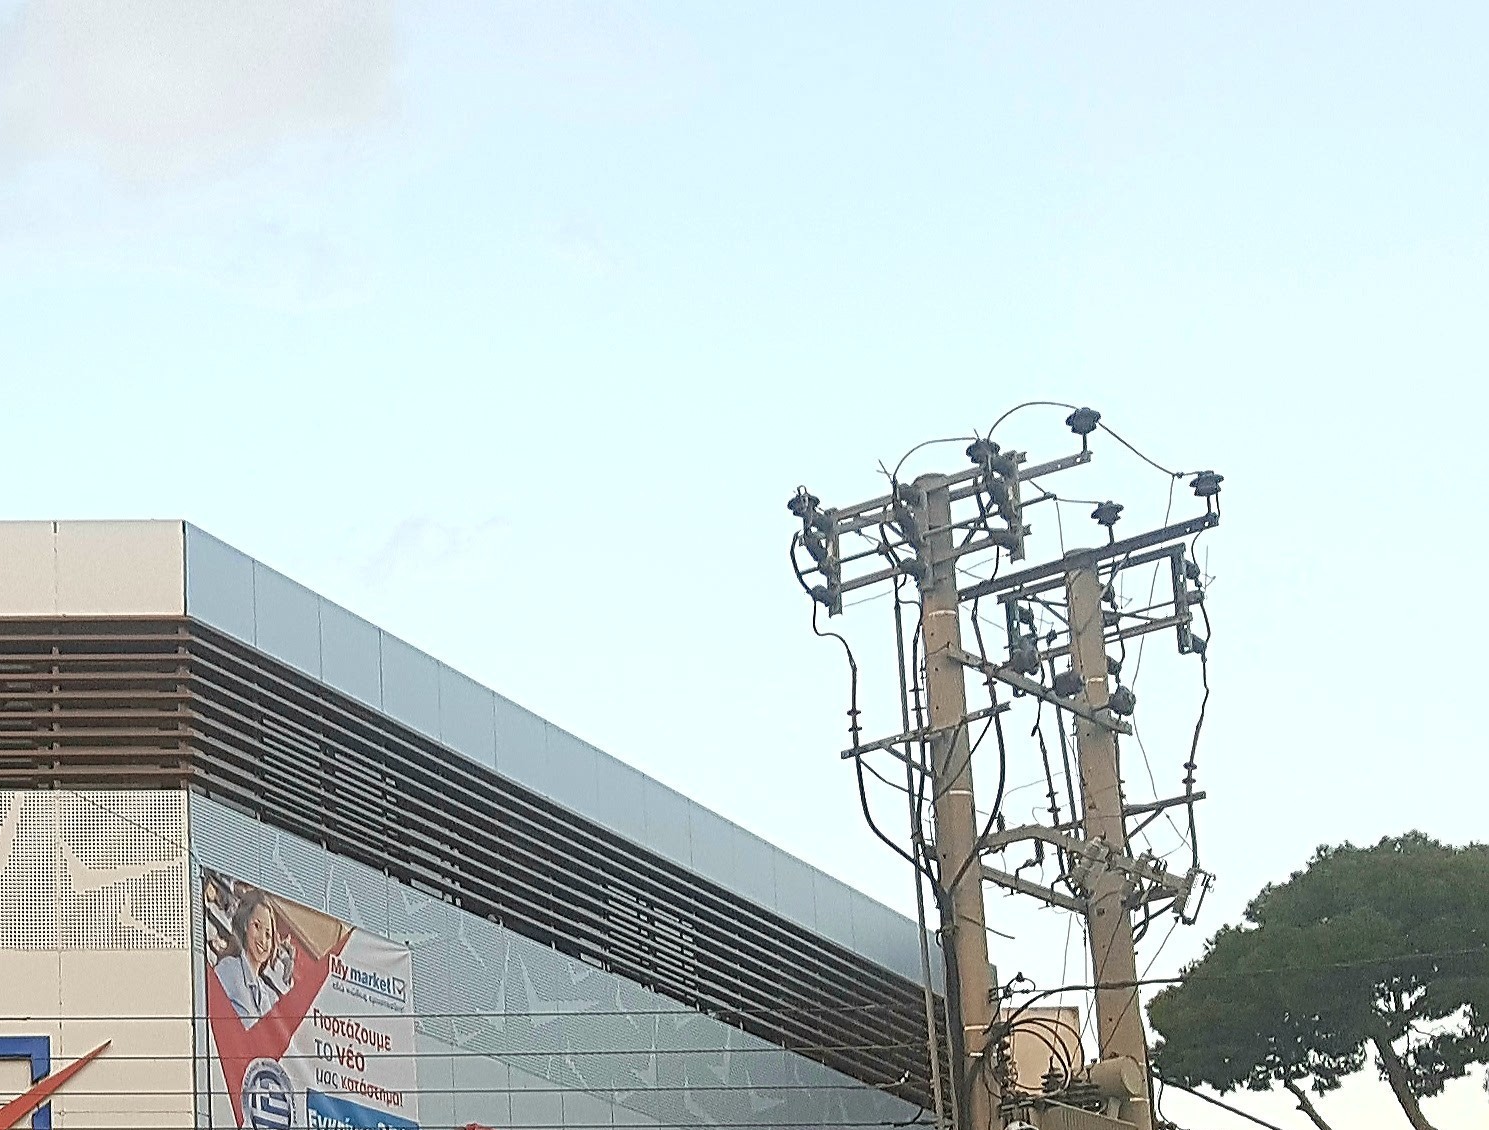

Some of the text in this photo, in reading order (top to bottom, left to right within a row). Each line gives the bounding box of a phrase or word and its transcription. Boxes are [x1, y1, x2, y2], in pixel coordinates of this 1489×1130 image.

[331, 957, 349, 980] My
[350, 967, 392, 995] market
[313, 1008, 392, 1051] Γιορτάζουμε
[314, 1038, 365, 1072] το νέο
[315, 1067, 339, 1089] μας
